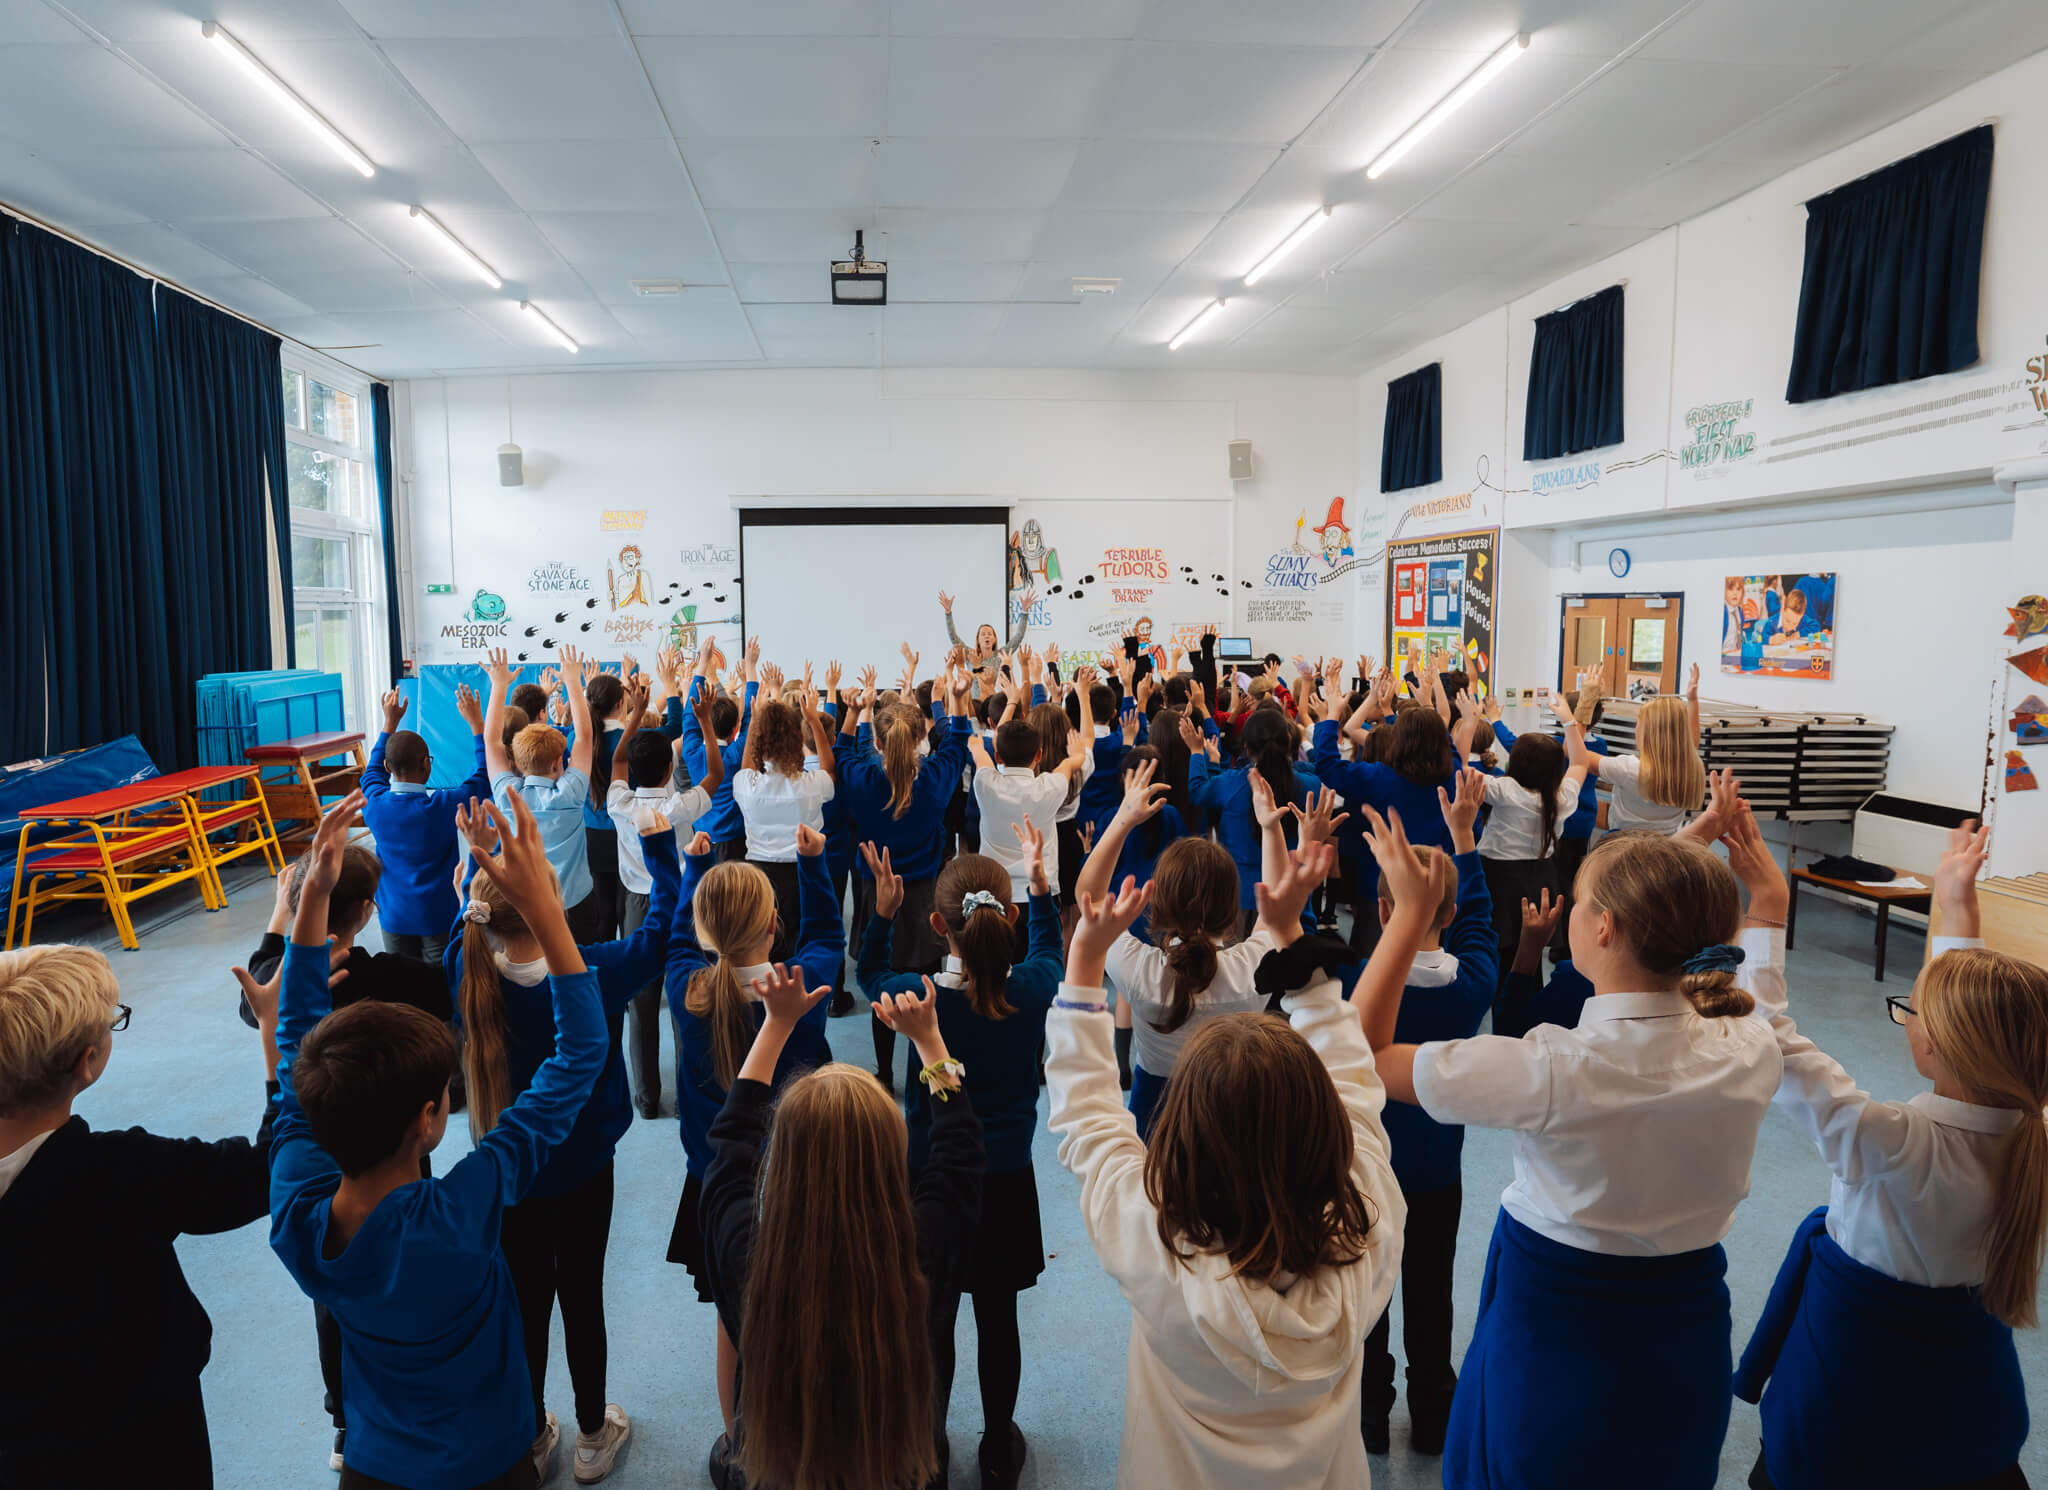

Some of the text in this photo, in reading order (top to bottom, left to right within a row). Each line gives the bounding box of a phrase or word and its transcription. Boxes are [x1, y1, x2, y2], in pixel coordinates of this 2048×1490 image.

[1696, 418, 1737, 444] FIRST
[1680, 434, 1754, 466] WORLD WAR
[1532, 462, 1600, 491] EDWARDIANS
[680, 550, 736, 562] IRON AGE
[1104, 549, 1162, 561] TERRIBLE
[1389, 544, 1418, 559] Celebrate
[1098, 562, 1168, 578] TUDORS
[1266, 553, 1311, 572] SLIMY
[533, 569, 577, 580] SAVAGE
[1265, 570, 1318, 591] STUARTS
[528, 579, 590, 592] STONE AGE
[1466, 580, 1491, 607] House
[1465, 600, 1491, 630] Points
[440, 624, 508, 637] MESOZOIC
[604, 620, 654, 633] BRONZE
[461, 636, 488, 649] ERA
[615, 632, 642, 642] AGE
